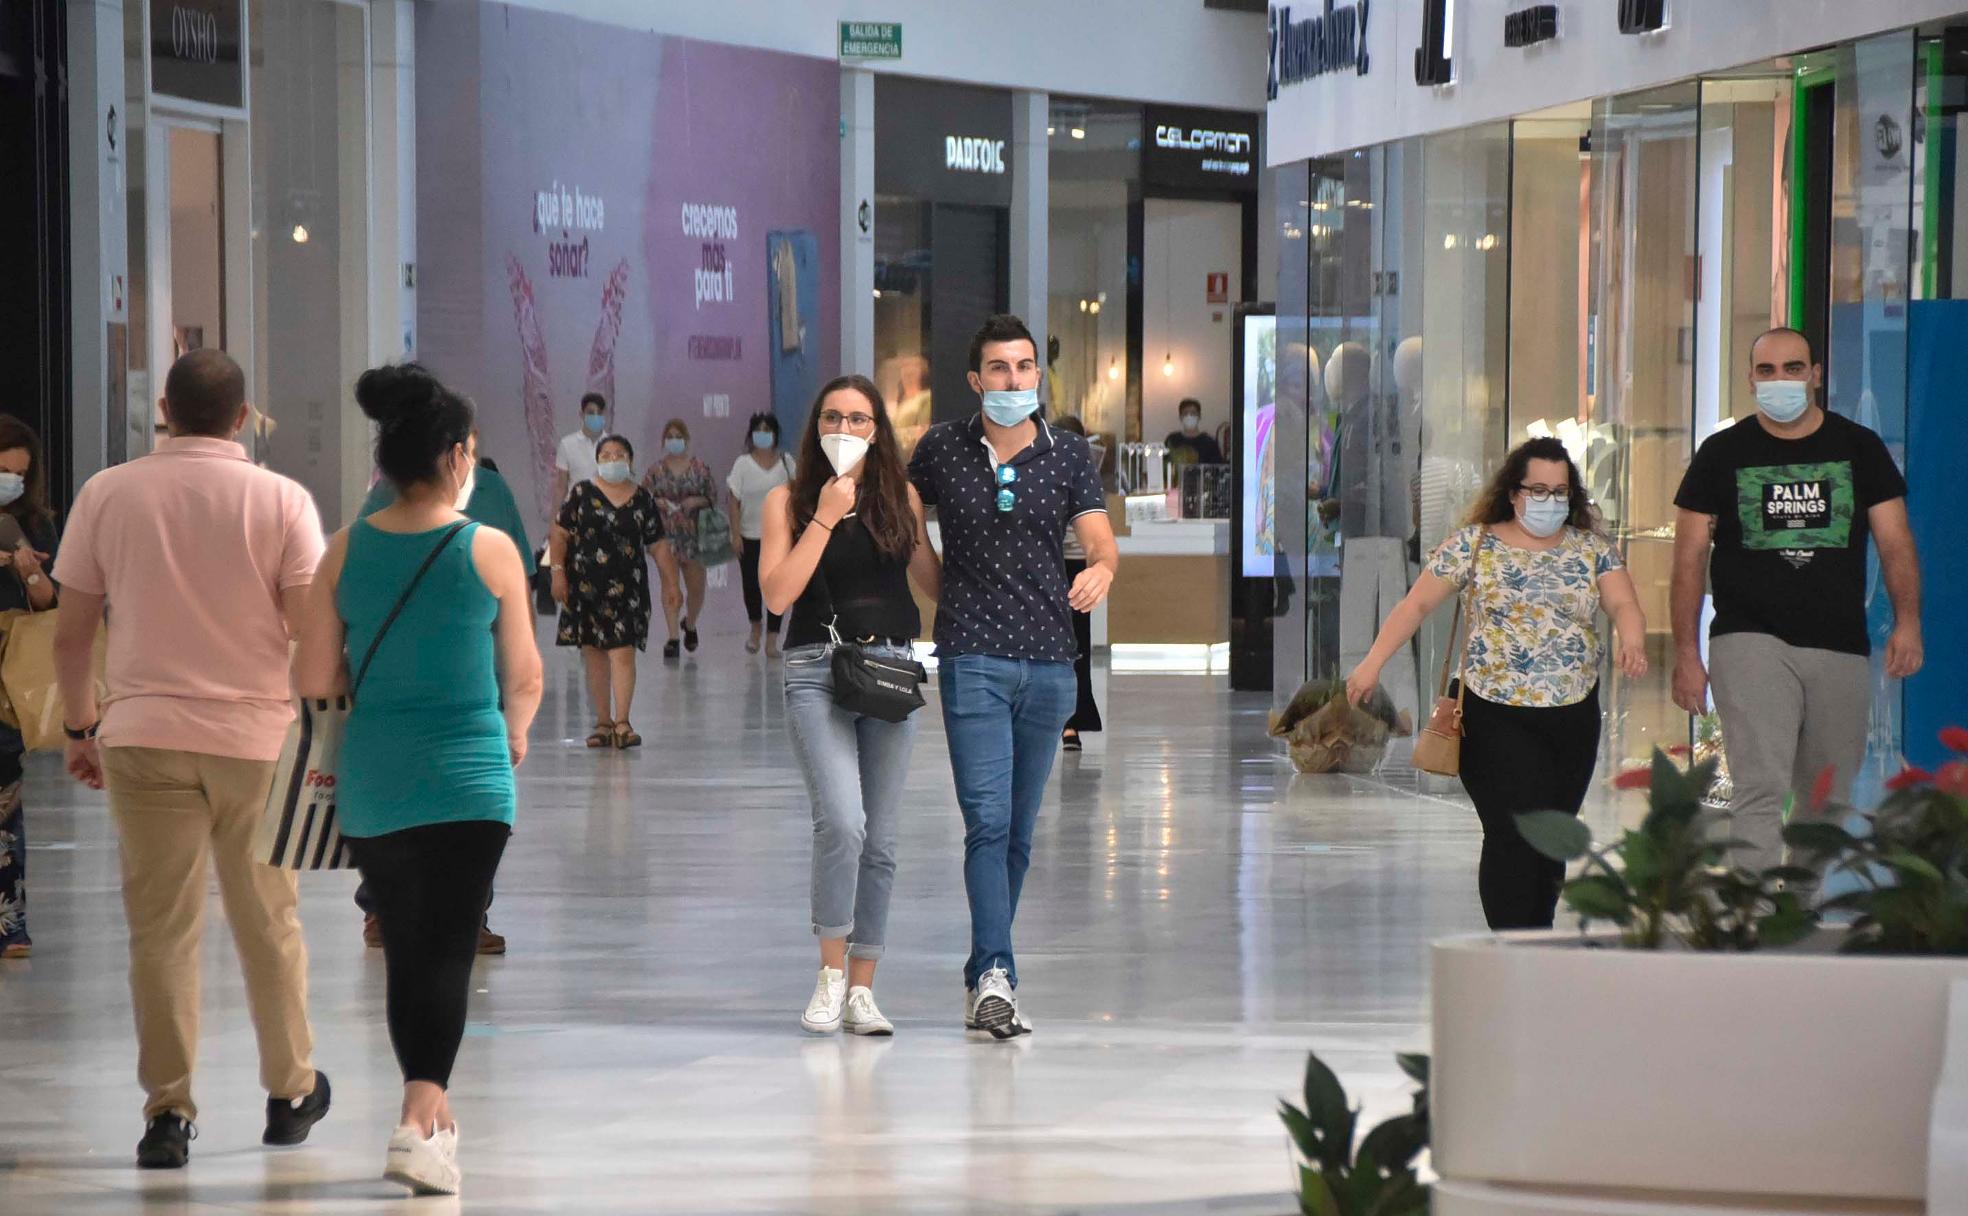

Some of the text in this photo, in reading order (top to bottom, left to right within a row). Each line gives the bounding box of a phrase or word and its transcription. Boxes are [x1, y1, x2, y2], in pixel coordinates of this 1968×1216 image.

[172, 5, 217, 64] OYSHO
[844, 40, 899, 56] EMERGENCIA
[849, 23, 893, 39] SALIDA DE
[562, 183, 573, 228] te
[576, 184, 604, 231] hace
[682, 201, 738, 239] crecemos
[549, 230, 588, 277] soñar?
[695, 259, 733, 310] para ti
[1767, 499, 1826, 514] SPRINGS
[1773, 482, 1819, 501] PALM
